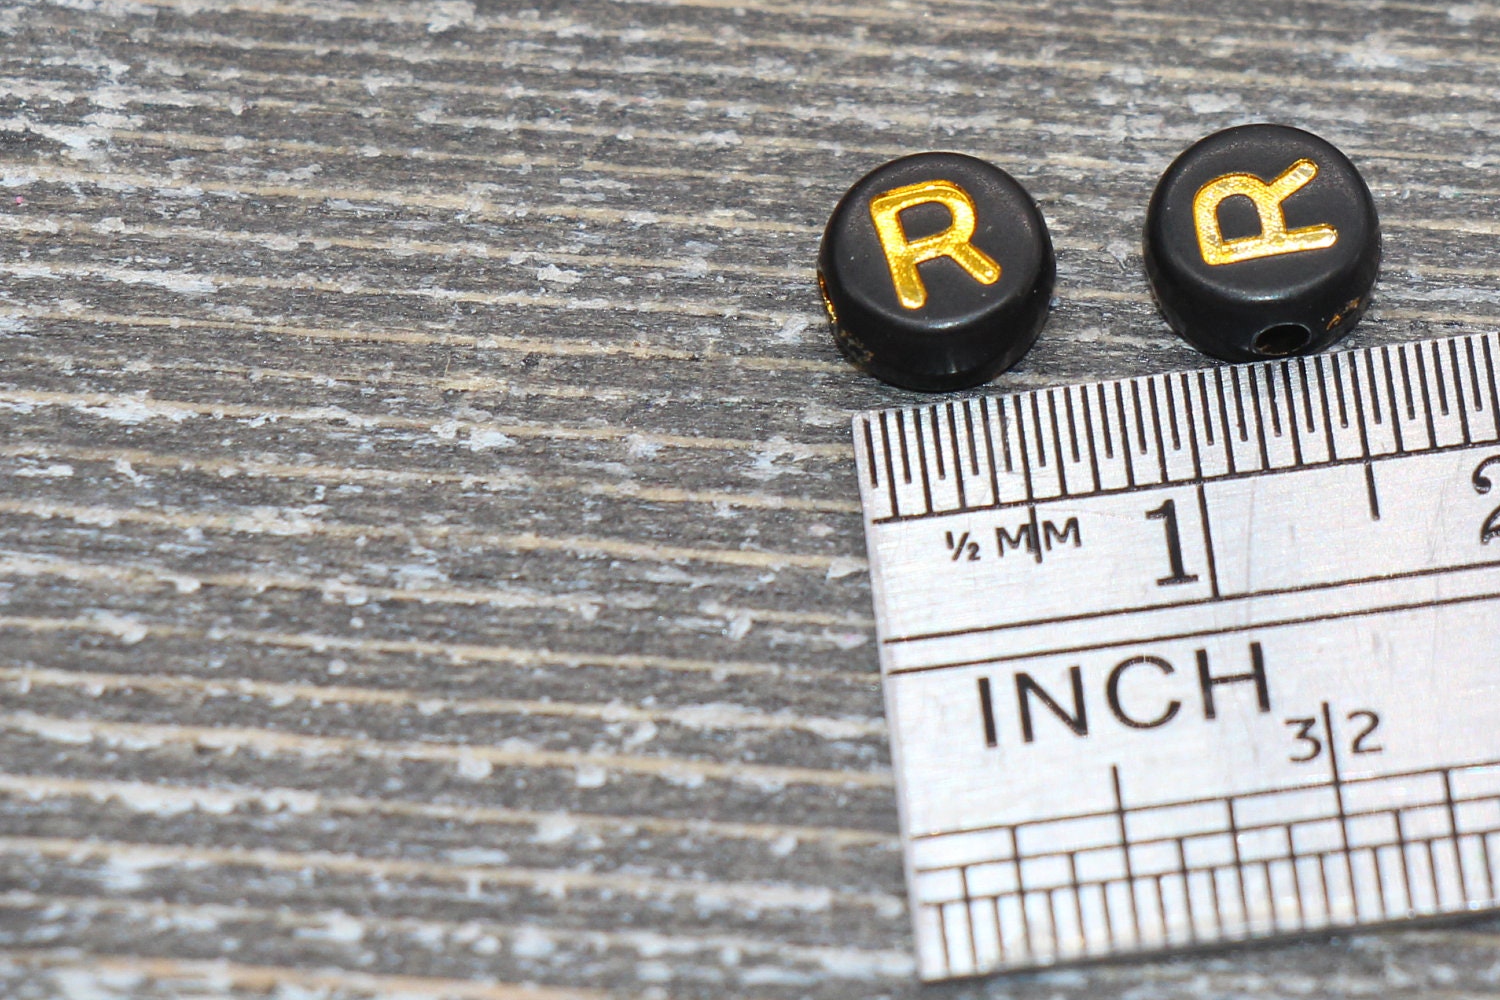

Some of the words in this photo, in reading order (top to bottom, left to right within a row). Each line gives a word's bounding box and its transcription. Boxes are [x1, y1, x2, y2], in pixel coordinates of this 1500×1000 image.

[870, 179, 1002, 310] R
[1193, 158, 1339, 266] R
[1144, 498, 1199, 587] 1
[976, 640, 1272, 749] INCH
